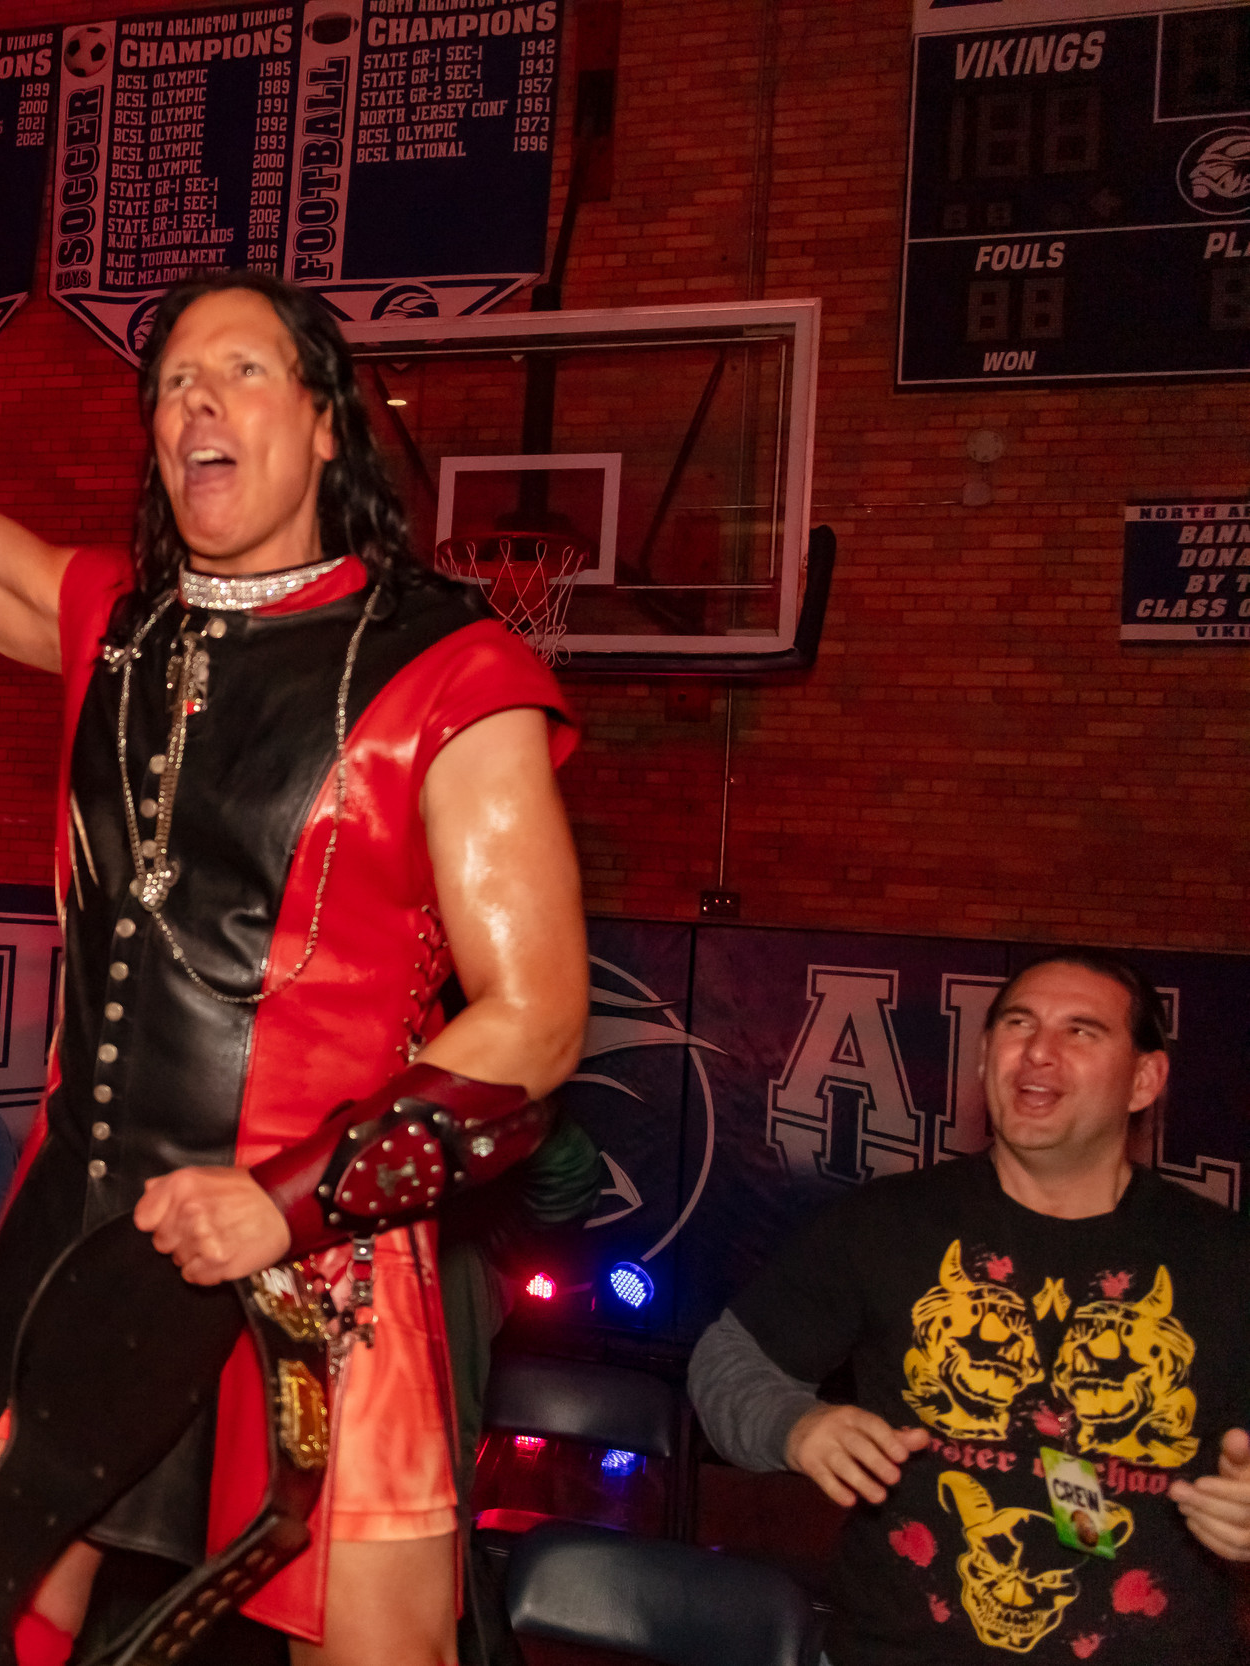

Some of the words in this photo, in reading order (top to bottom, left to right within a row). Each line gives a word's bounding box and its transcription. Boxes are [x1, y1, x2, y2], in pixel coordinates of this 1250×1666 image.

[122, 20, 163, 36] NORTH
[167, 13, 237, 36] ARLINGTON
[242, 7, 294, 29] VIKINGS
[367, 1, 557, 47] CHAMPIONS
[7, 33, 53, 50] VIKINGS
[120, 24, 292, 68] CHAMPIONS
[364, 52, 407, 70] STATE
[412, 47, 441, 64] GR-1
[446, 45, 483, 62] SEC-1
[521, 39, 556, 56] 1942
[955, 30, 1106, 80] VIKINGS
[117, 74, 148, 90] BCSL
[153, 69, 209, 89] OLYMPIC
[259, 61, 291, 78] 1985
[362, 70, 406, 88] STATE
[411, 67, 439, 85] GR-1
[445, 64, 481, 81] SEC-1
[519, 58, 554, 76] 1943
[20, 82, 50, 98] 1999
[361, 90, 404, 107] STATE
[410, 86, 442, 103] GR-2
[447, 83, 483, 99] SEC-1
[518, 77, 552, 95] 1957
[19, 100, 48, 115] 2000
[114, 110, 146, 126] BCSL
[151, 105, 205, 124] OLYMPIC
[256, 99, 288, 115] 1991
[359, 108, 406, 126] NORTH
[411, 103, 467, 121] JERSEY
[472, 100, 509, 117] CONF
[516, 97, 551, 114] 1961
[17, 117, 45, 131] 2021
[358, 128, 391, 144] BCSL
[397, 123, 458, 142] OLYMPIC
[514, 117, 550, 133] 1973
[16, 133, 45, 147] 2022
[113, 145, 144, 162] BCSL
[149, 142, 203, 160] OLYMPIC
[254, 135, 286, 150] 1993
[356, 147, 390, 164] BCSL
[396, 141, 466, 161] NATIONAL
[513, 136, 548, 152] 1996
[56, 85, 104, 268] SOCCER
[111, 164, 143, 179] BCSL
[147, 159, 202, 177] OLYMPIC
[253, 153, 284, 169] 2000
[292, 56, 349, 281] FOOTBALL
[109, 183, 151, 198] STATE
[155, 180, 180, 195] GR-1
[185, 176, 219, 192] SEC-1
[252, 172, 283, 187] 2000
[107, 218, 148, 234] STATE
[152, 216, 178, 231] GR-1
[182, 213, 216, 229] SEC-1
[249, 209, 281, 224] 2002
[107, 233, 137, 249] NJIC
[141, 228, 234, 247] MEADOWLANDS
[248, 224, 279, 240] 2015
[106, 252, 136, 268] NJIC
[140, 248, 226, 266] TOURNAMENT
[247, 244, 278, 260] 2016
[975, 241, 1065, 271] FOULS
[55, 270, 91, 291] BOYS
[983, 351, 1036, 372] WON
[1140, 508, 1216, 519] NORTH
[1185, 574, 1225, 593] BY
[1137, 598, 1228, 618] CLASS
[1052, 1478, 1099, 1512] CREW
